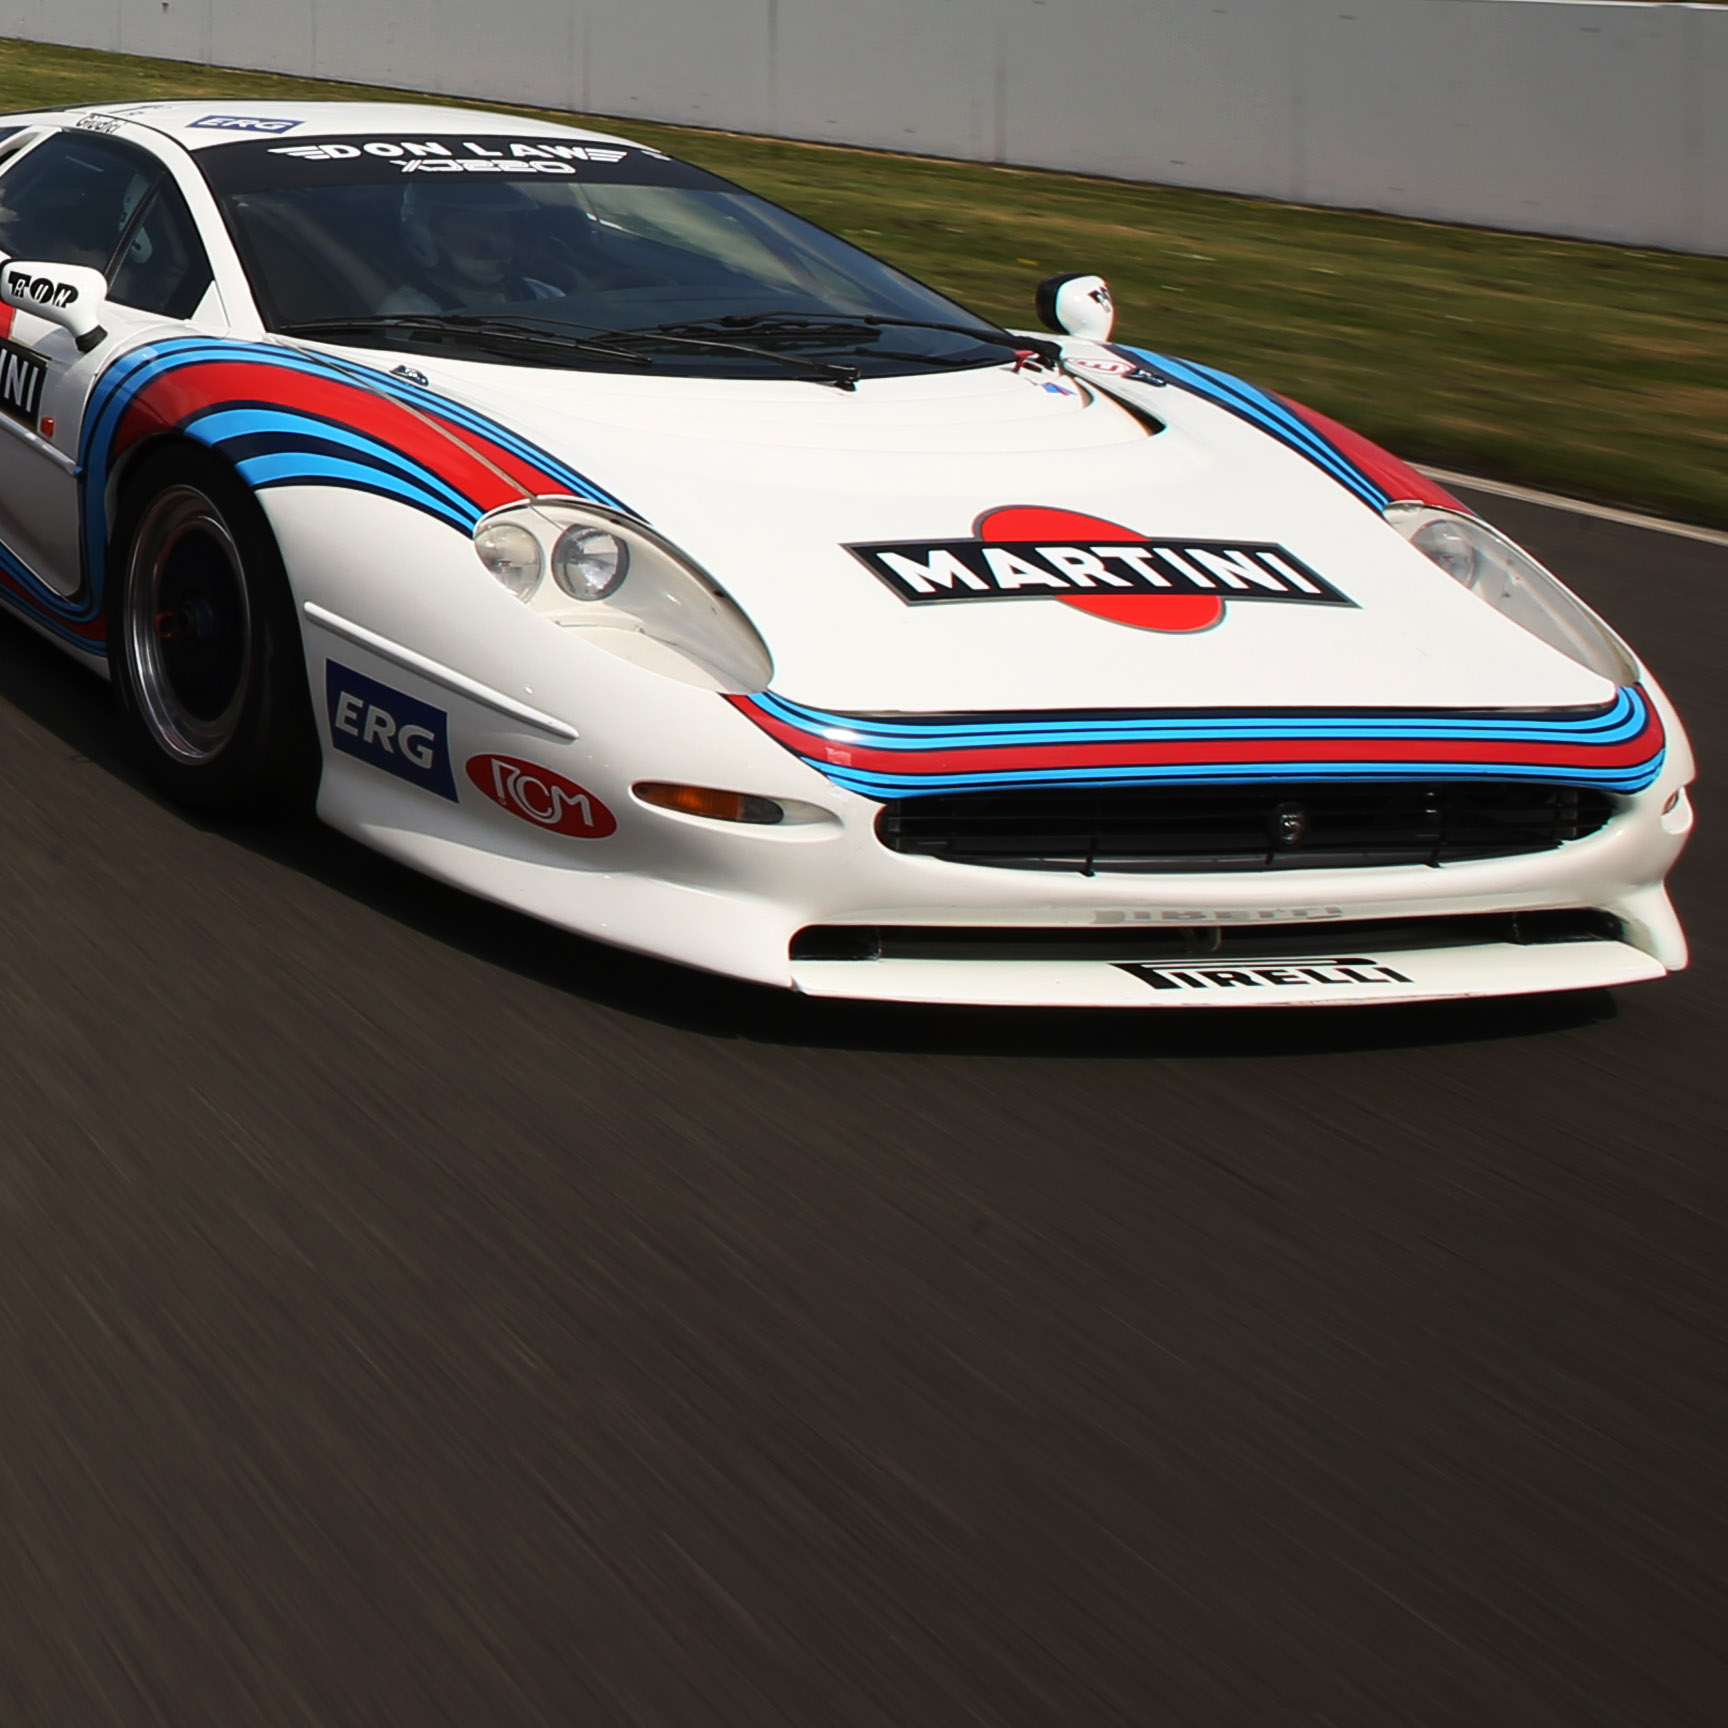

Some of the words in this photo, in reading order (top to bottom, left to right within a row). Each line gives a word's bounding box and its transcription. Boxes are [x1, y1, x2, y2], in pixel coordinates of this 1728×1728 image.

[326, 142, 453, 159] DON
[463, 142, 591, 161] LAW
[391, 159, 576, 173] XJ220
[876, 546, 1323, 594] MARTINI
[335, 691, 436, 769] ERG
[1106, 957, 1415, 990] PIRELLI
